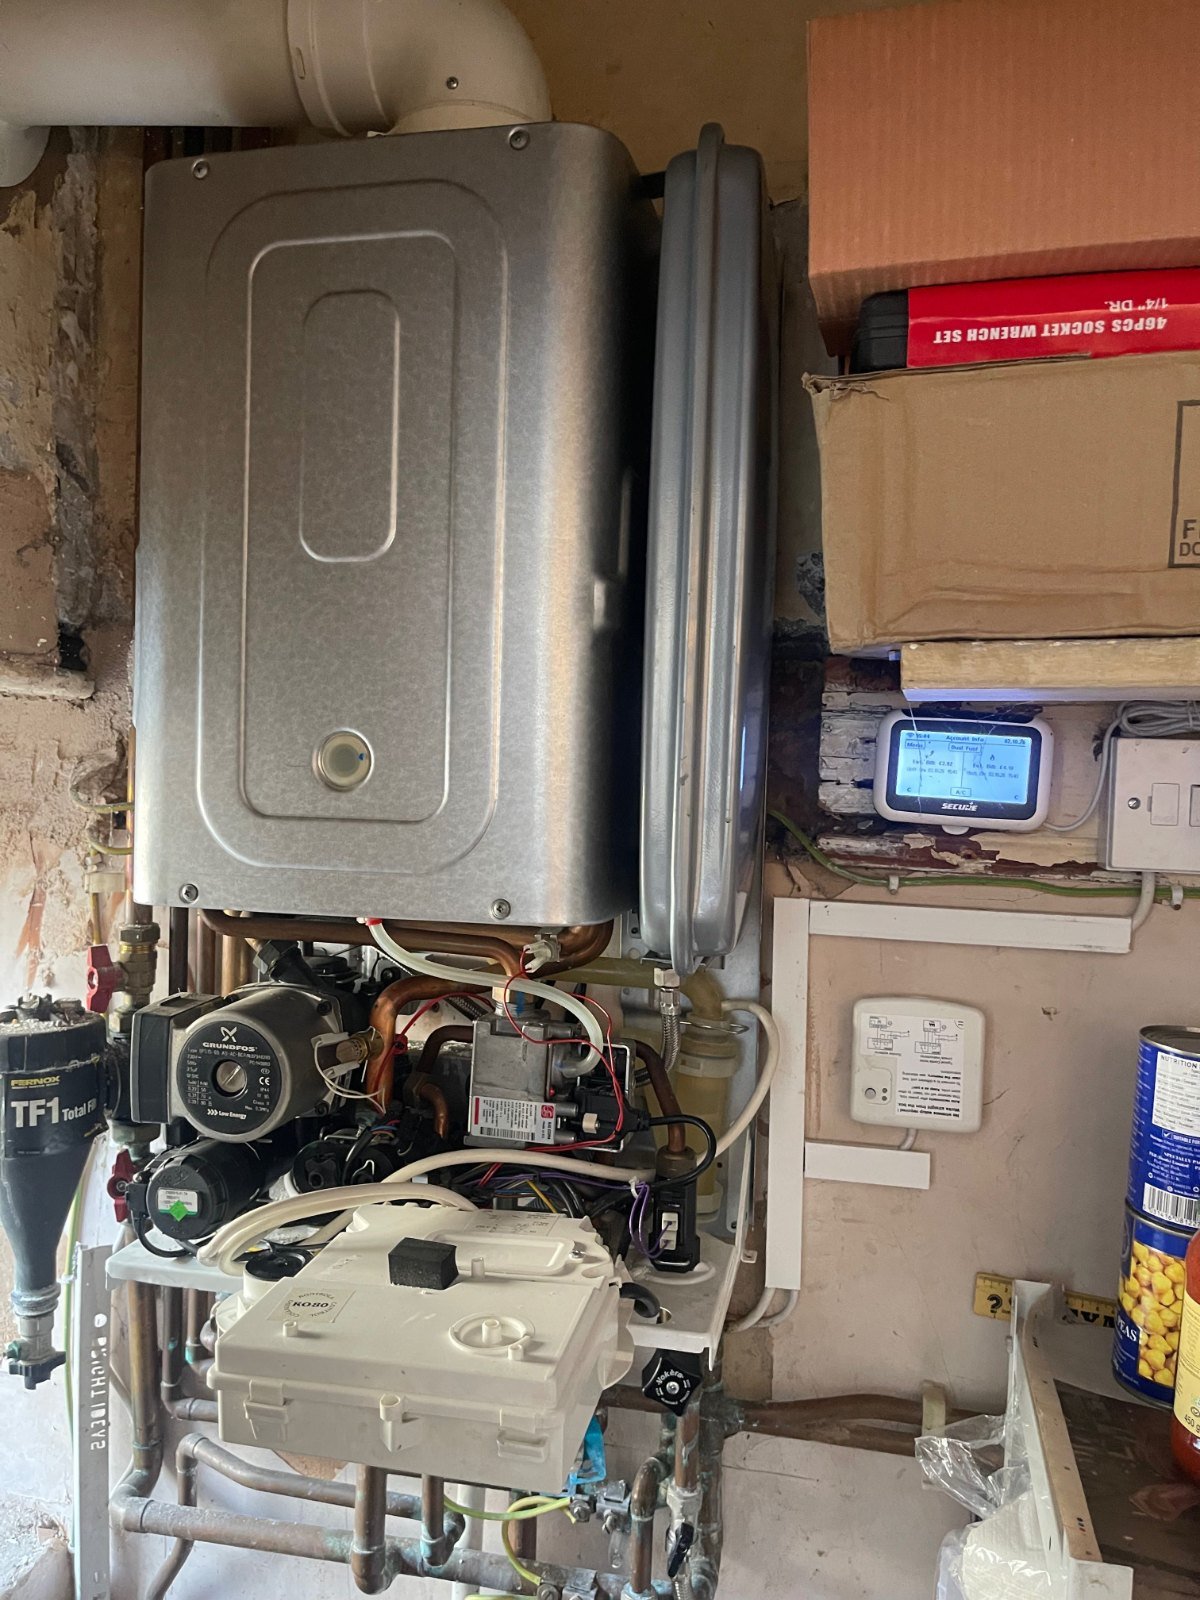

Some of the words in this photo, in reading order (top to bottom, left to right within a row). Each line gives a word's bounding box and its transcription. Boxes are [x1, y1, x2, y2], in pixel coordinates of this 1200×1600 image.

[1104, 299, 1133, 313] DR.
[1041, 320, 1105, 337] SOCKET
[1111, 317, 1168, 333] 46PCS
[933, 329, 962, 344] SET
[966, 324, 1037, 342] WRENCH
[941, 802, 979, 812] SECURE
[203, 1042, 255, 1052] GRUNDFOS
[1161, 1055, 1198, 1069] NUTRITION
[11, 1075, 60, 1087] FERNOX
[10, 1096, 59, 1128] TF1
[62, 1102, 86, 1121] Total
[1184, 1414, 1194, 1427] 450
